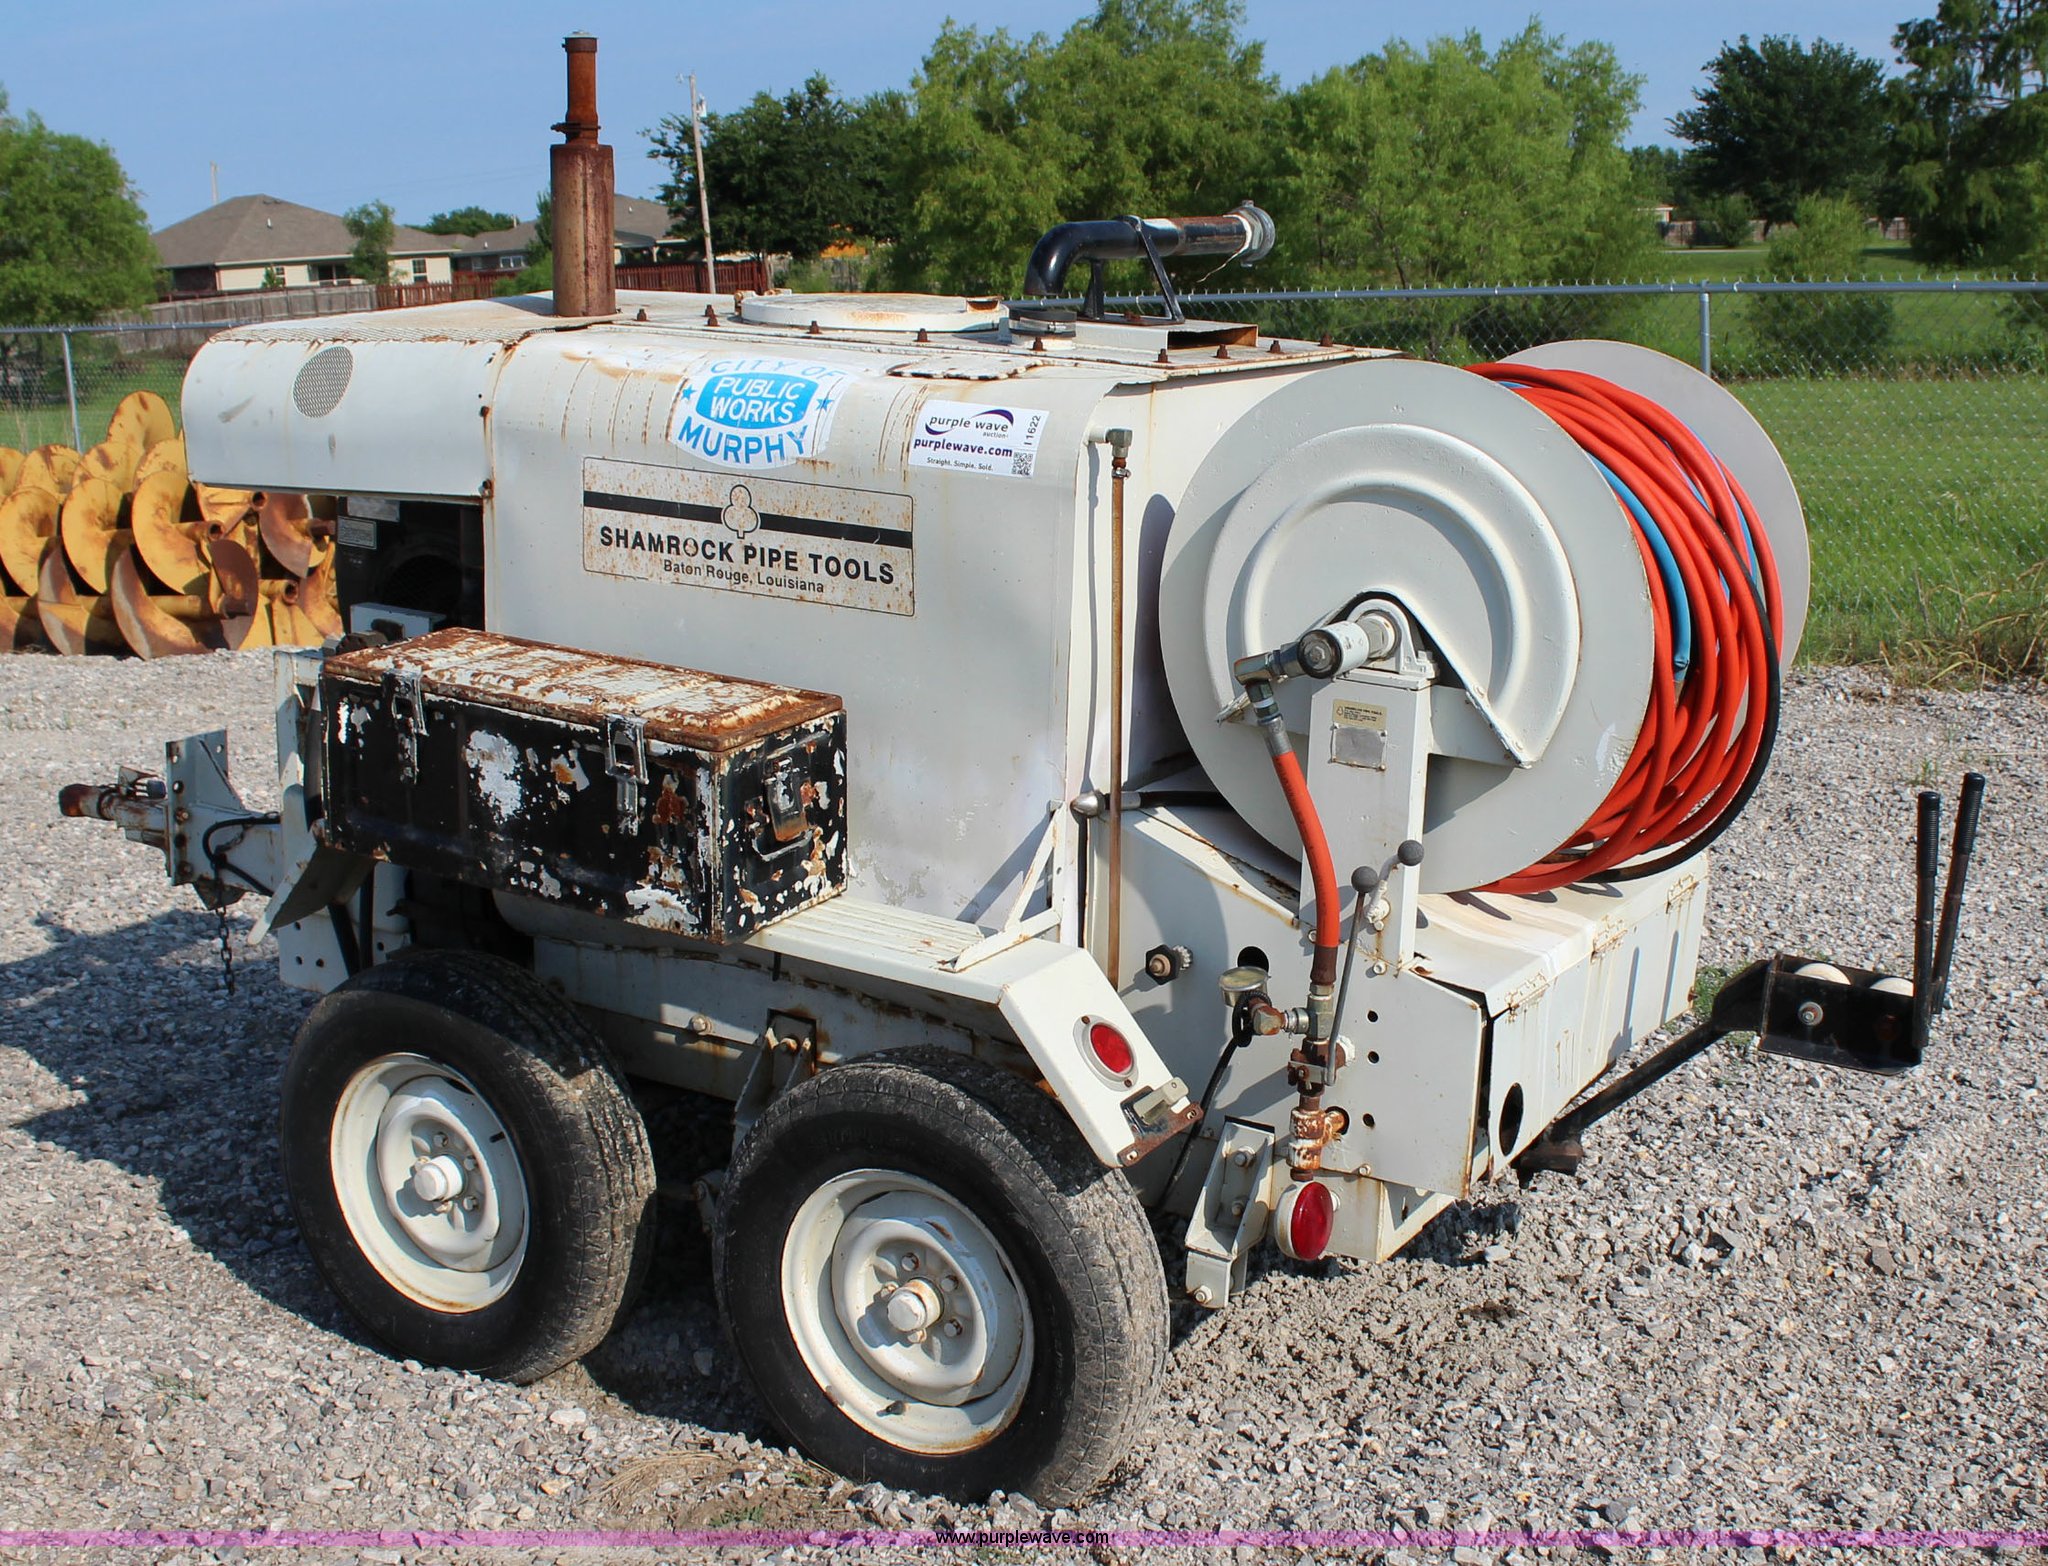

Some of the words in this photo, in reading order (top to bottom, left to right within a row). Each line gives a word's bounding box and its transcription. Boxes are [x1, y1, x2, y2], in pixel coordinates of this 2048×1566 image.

[710, 359, 796, 374] CITY
[801, 366, 848, 380] OF
[714, 376, 806, 400] PUBLIC
[710, 396, 796, 424] WORKS
[929, 416, 970, 429] purple
[975, 421, 1009, 432] wave
[678, 416, 808, 465] MURPHY
[913, 438, 1013, 457] purplewave.com
[927, 457, 952, 467] Straight.
[954, 460, 976, 470] Simple.
[978, 463, 994, 471] Sold.
[600, 525, 734, 563] SHAMROCK
[743, 545, 798, 572] PIPE
[808, 553, 894, 585] TOOLS
[664, 559, 702, 576] Baton
[706, 565, 752, 585] Rouge,
[757, 572, 824, 593] Louisiana
